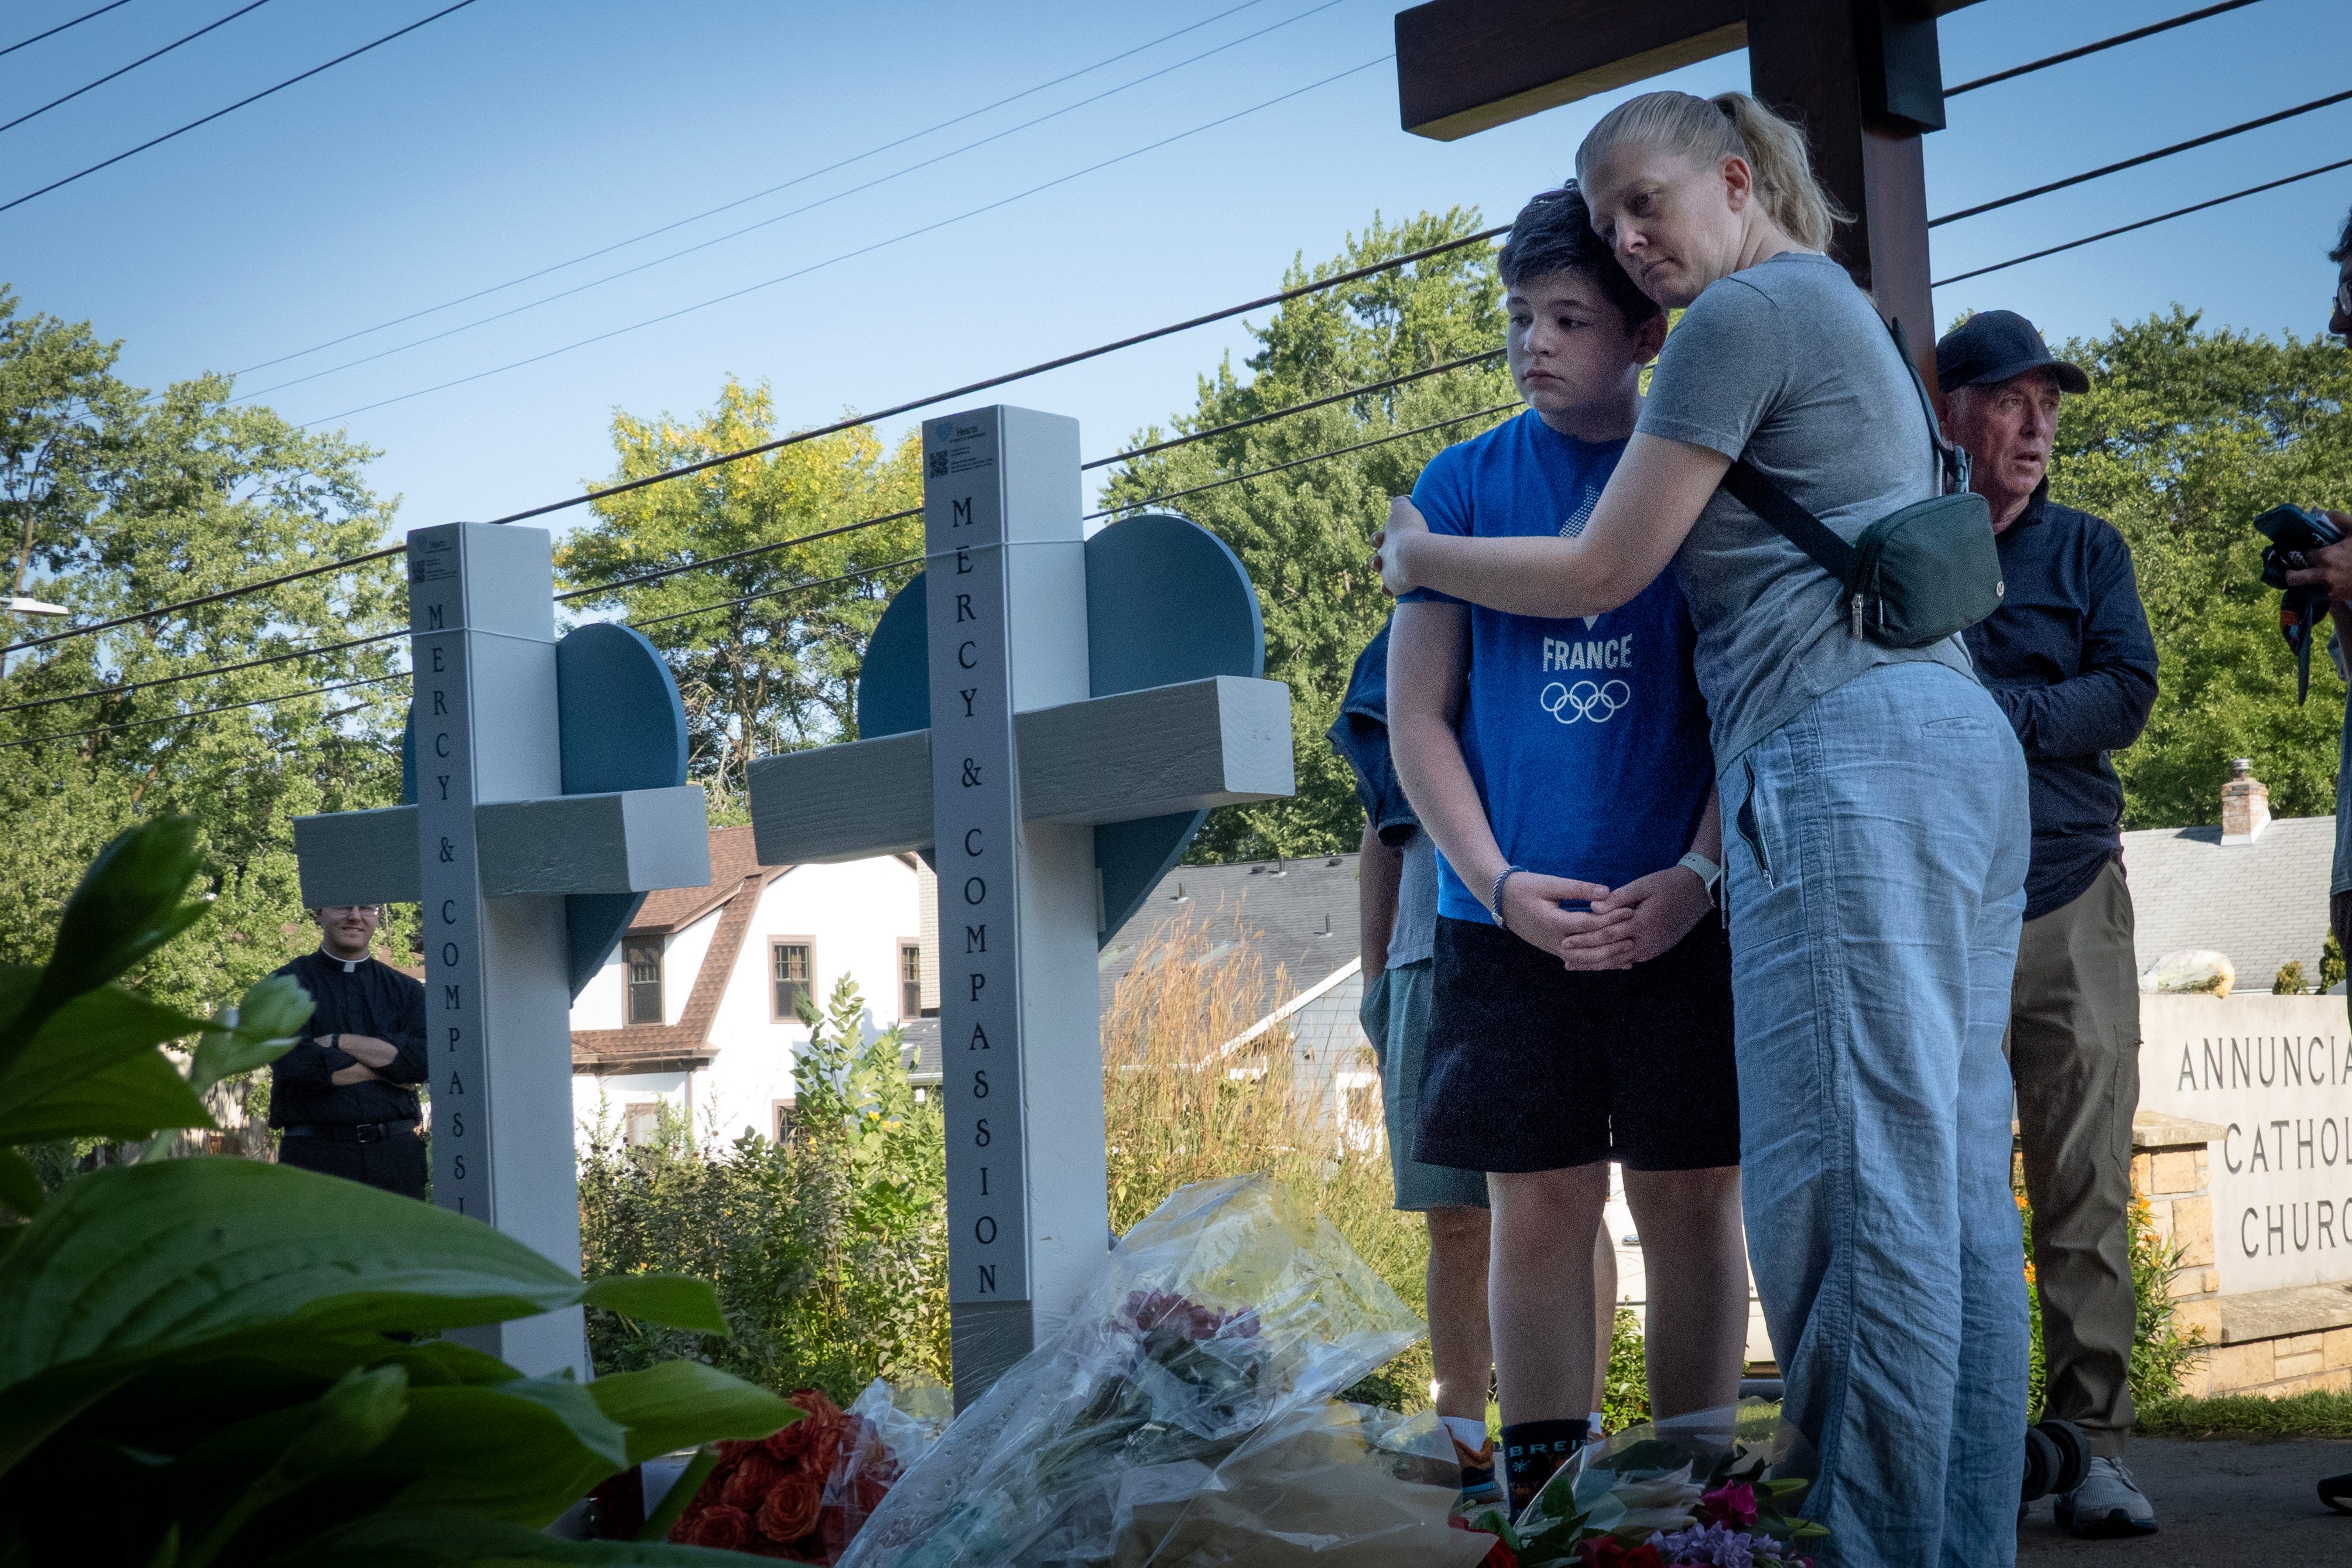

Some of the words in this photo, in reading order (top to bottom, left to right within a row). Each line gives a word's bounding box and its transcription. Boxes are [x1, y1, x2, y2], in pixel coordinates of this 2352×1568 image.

[428, 604, 450, 800] MERCY
[952, 497, 978, 717] MERCY
[1543, 633, 1632, 672] FRANCE
[440, 837, 455, 863] &
[962, 758, 983, 788] &
[443, 899, 465, 1214] COMPASSI
[964, 828, 997, 1293] COMPASSION
